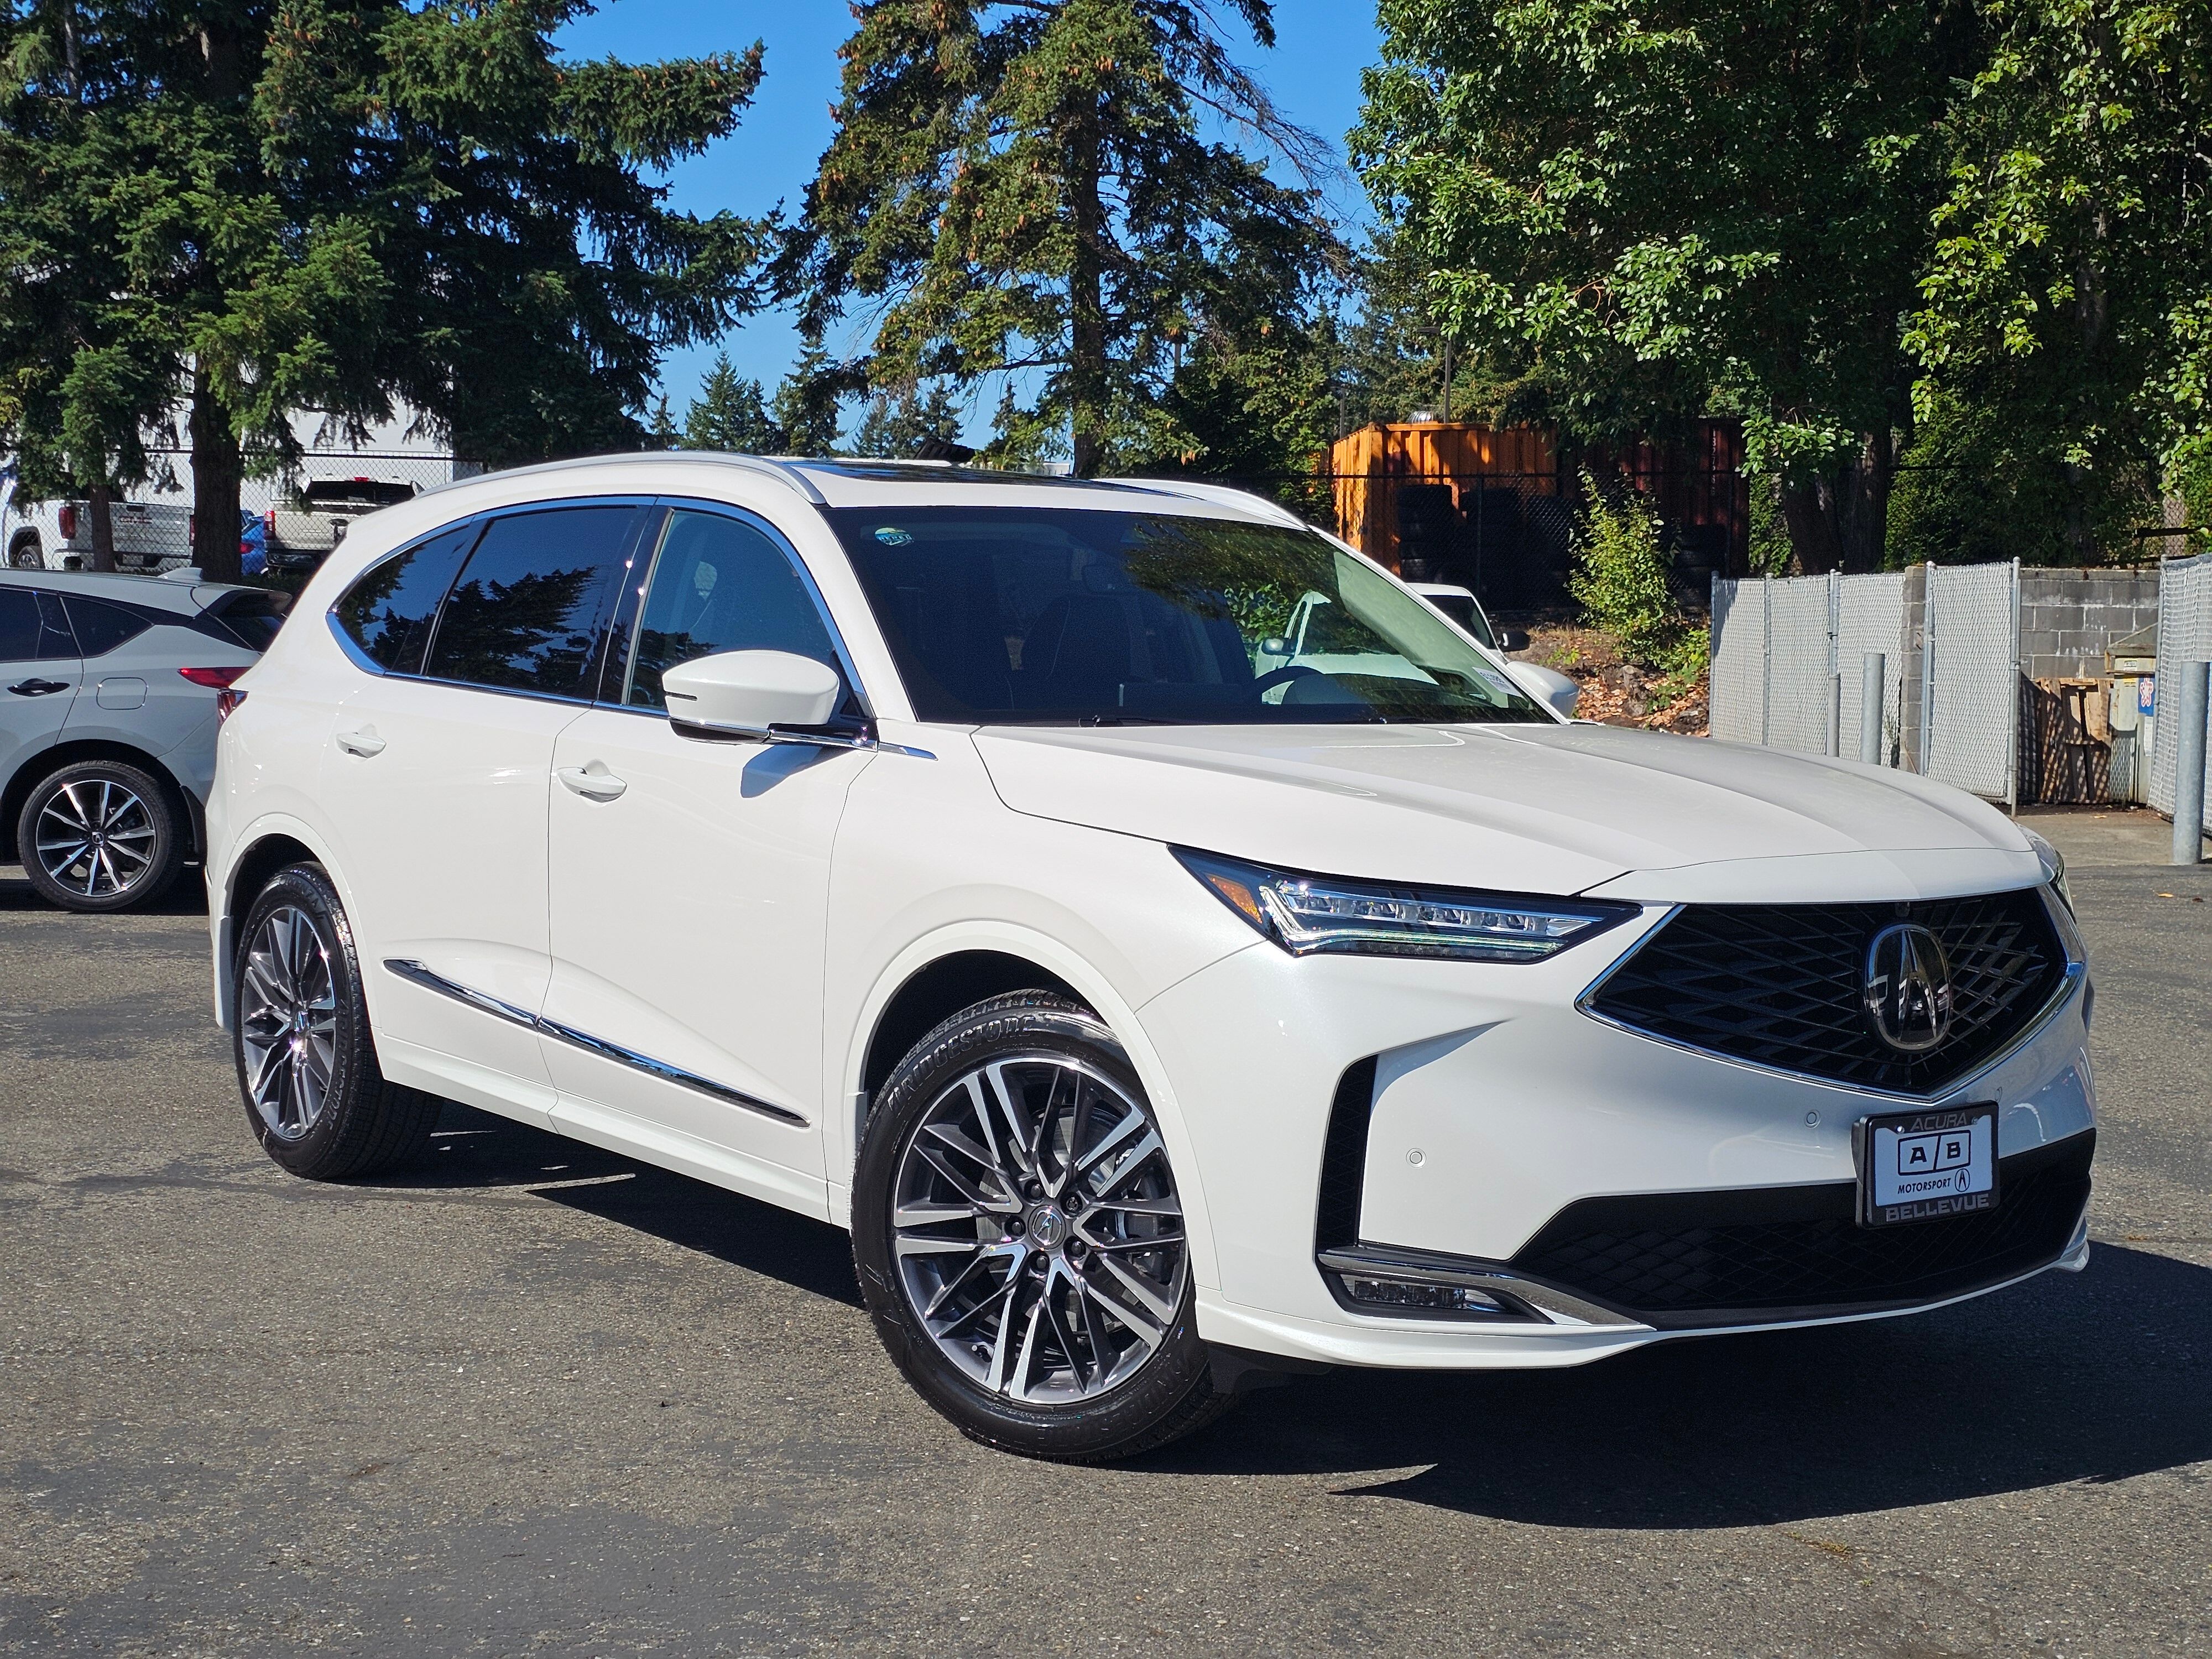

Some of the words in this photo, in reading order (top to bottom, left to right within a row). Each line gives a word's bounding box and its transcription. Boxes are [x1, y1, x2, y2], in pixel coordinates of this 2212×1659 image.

[886, 1015, 1036, 1117] BRIDGESTONE
[1910, 1112, 1967, 1133] ACURA
[1909, 1146, 1927, 1165] A
[1945, 1141, 1961, 1160] B
[1897, 1177, 1952, 1194] MOTORSPORT
[1885, 1193, 1990, 1222] BELLEVUE
